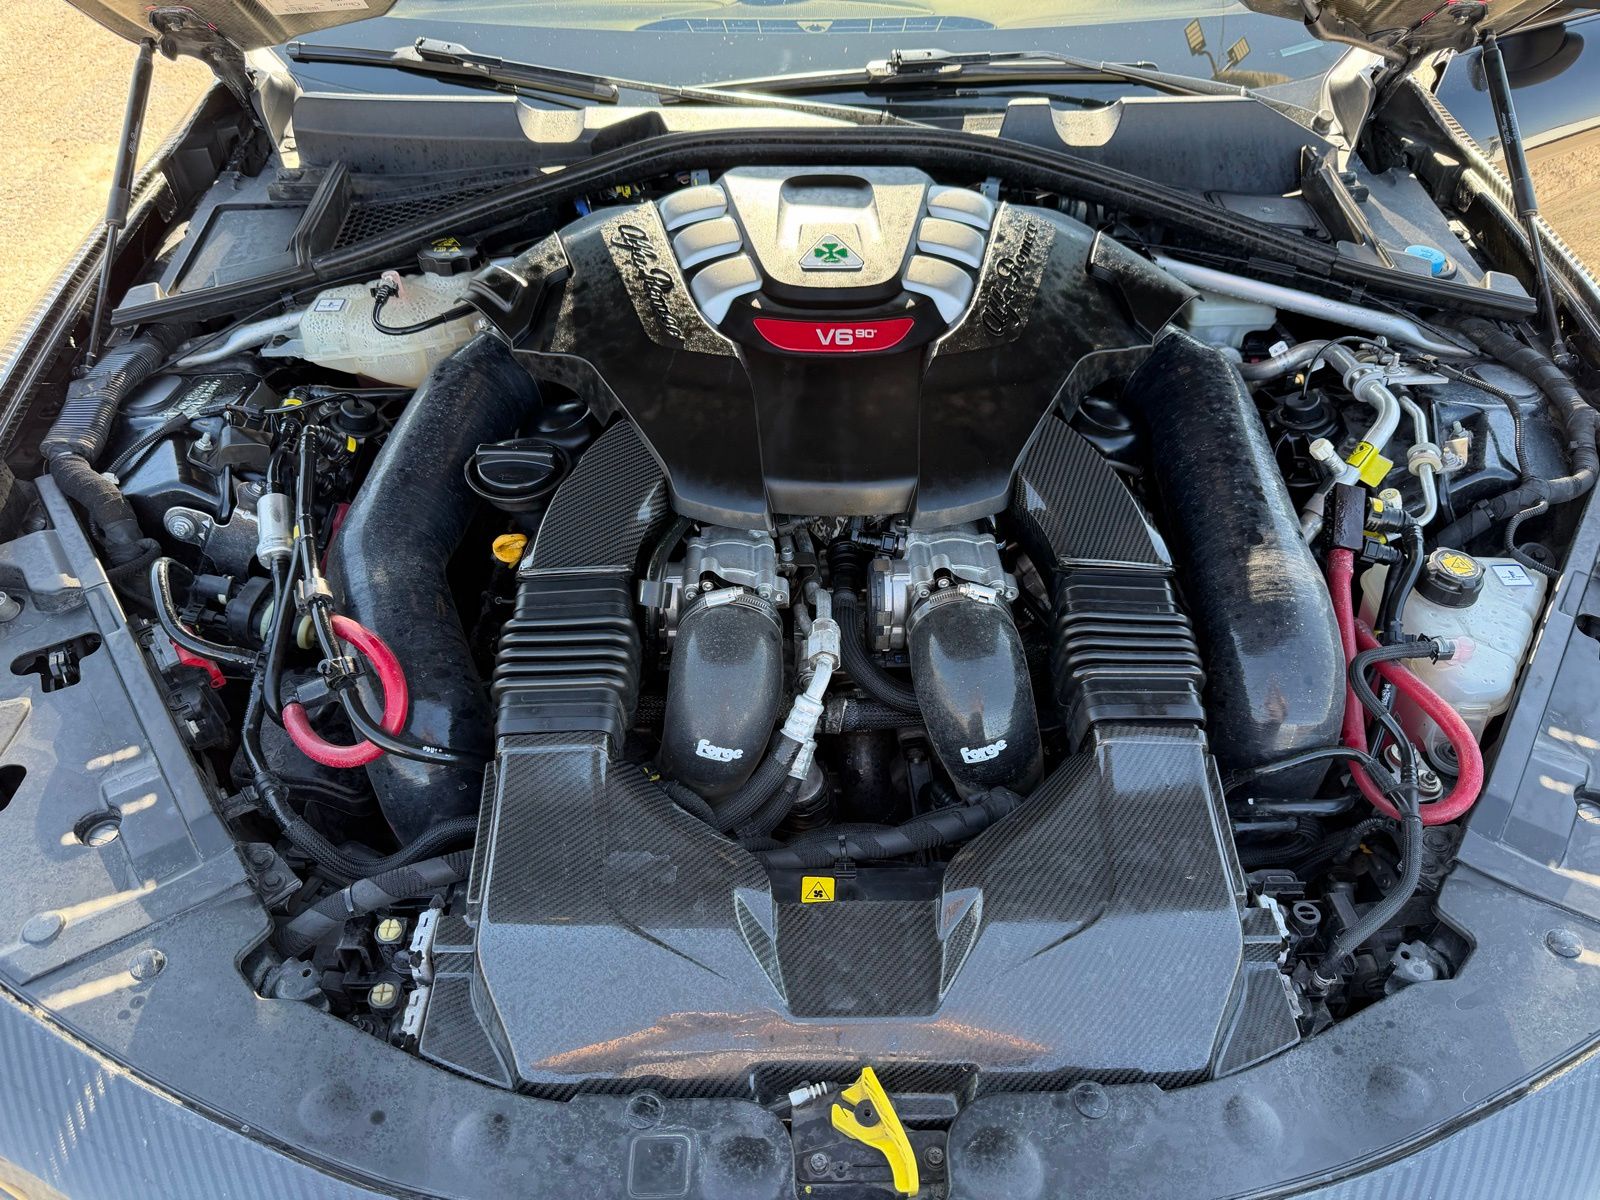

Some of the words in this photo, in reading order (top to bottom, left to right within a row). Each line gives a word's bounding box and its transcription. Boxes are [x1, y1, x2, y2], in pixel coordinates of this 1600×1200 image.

[611, 224, 658, 268] Alfa
[637, 268, 686, 340] Romeo
[996, 220, 1038, 285] Romeo
[815, 328, 854, 346] V6
